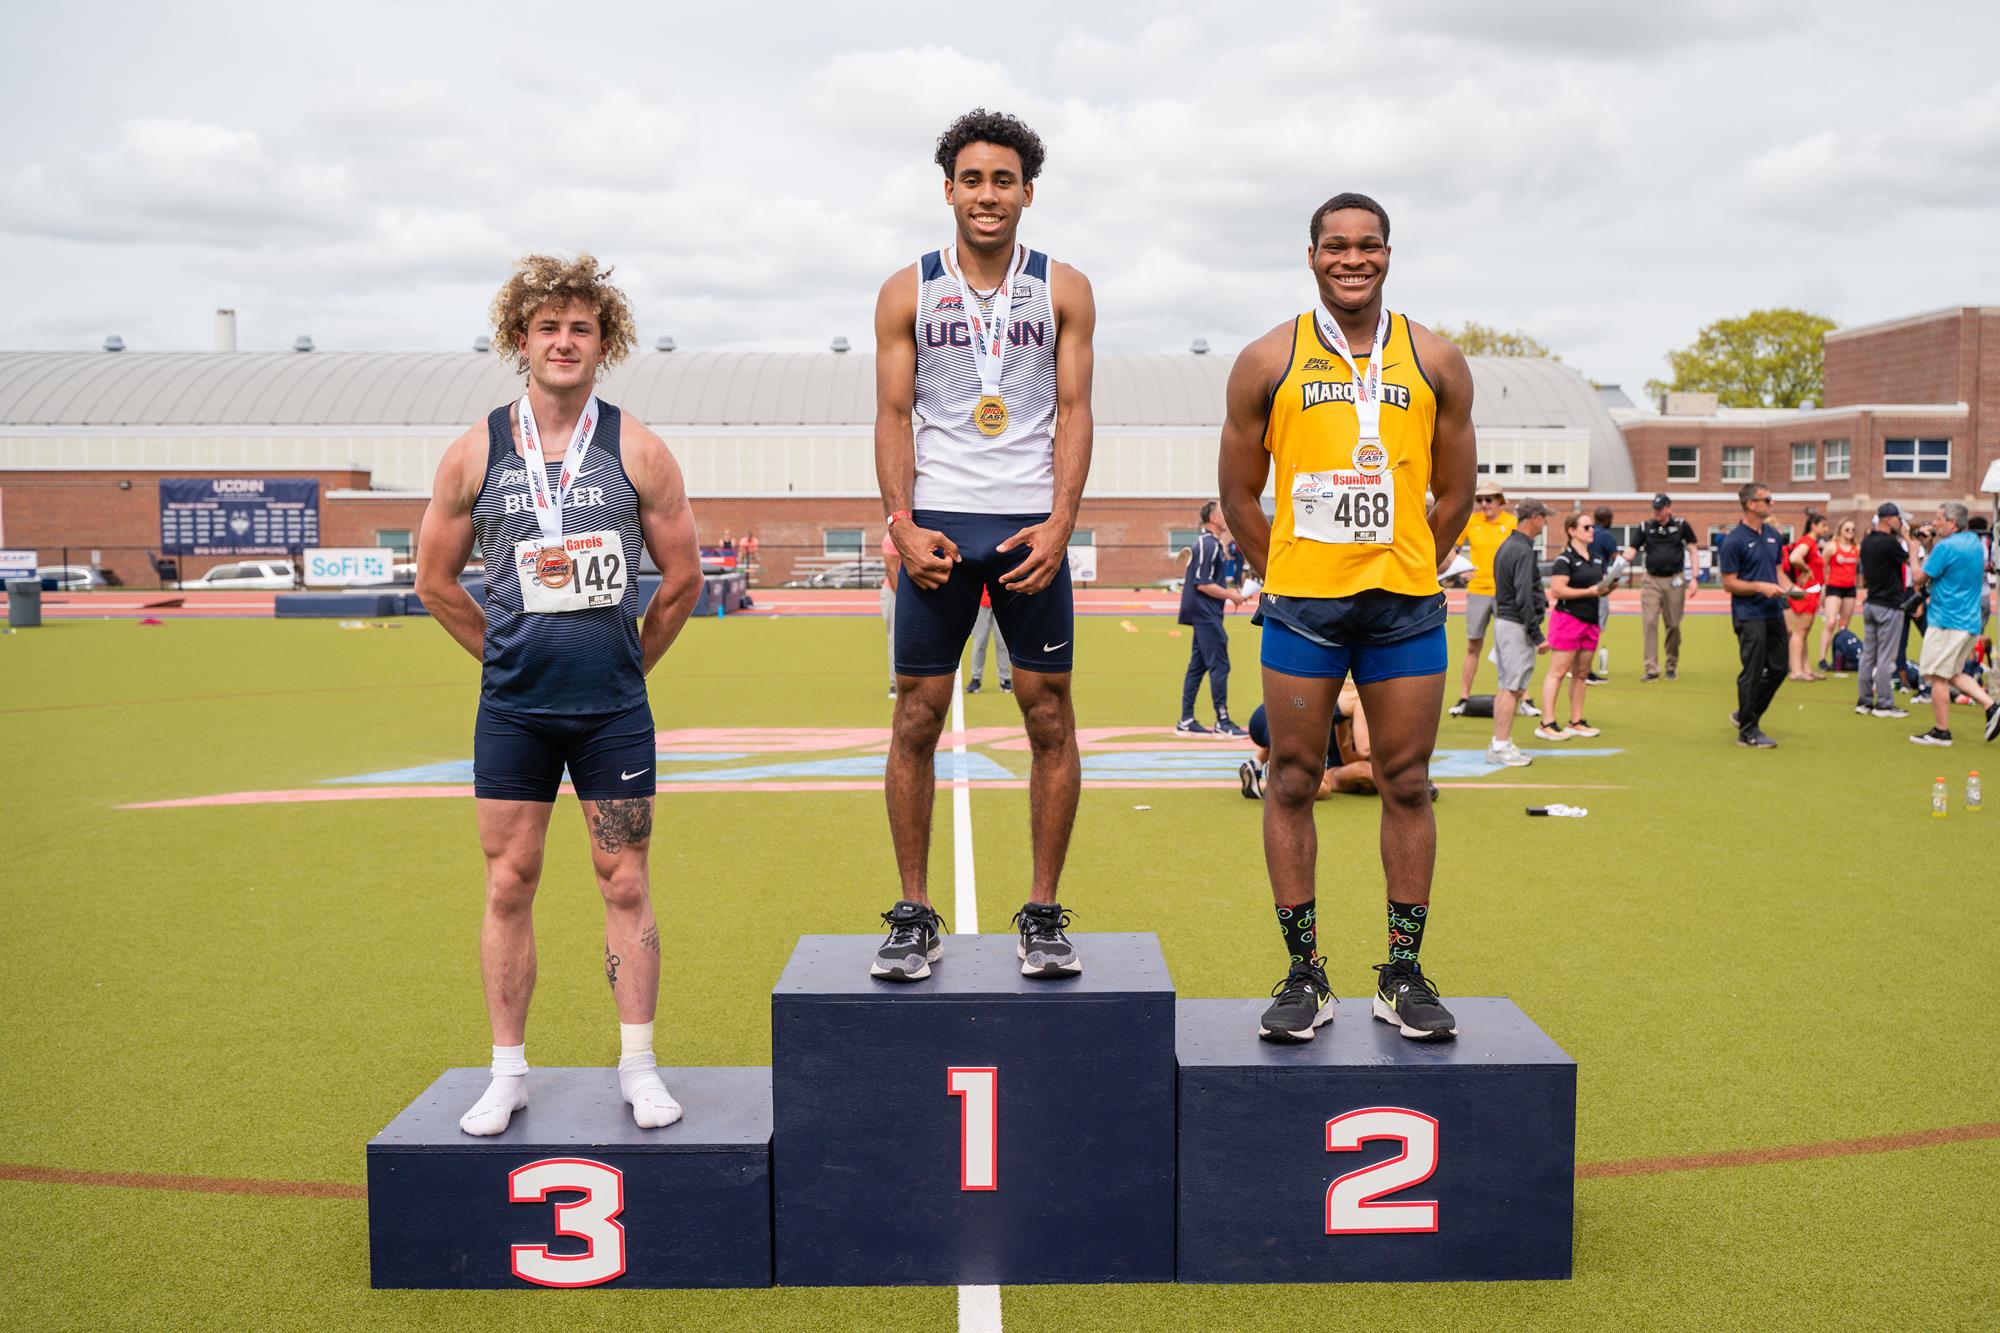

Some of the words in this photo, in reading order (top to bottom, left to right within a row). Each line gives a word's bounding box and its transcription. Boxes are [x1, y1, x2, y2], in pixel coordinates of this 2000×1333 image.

[940, 296, 963, 304] BIG
[925, 320, 1045, 347] UCNN
[973, 316, 983, 333] BIG
[978, 332, 988, 356] EAST
[994, 316, 1002, 340] EAST
[1323, 323, 1339, 339] EAST
[991, 339, 999, 356] BIG
[1302, 382, 1410, 412] MARQTTE
[583, 418, 592, 432] BIG
[577, 432, 587, 453] EAST
[213, 479, 265, 493] UCONN
[532, 469, 541, 492] EAST
[503, 487, 607, 514] BUER
[536, 491, 546, 508] BIG
[1334, 492, 1389, 528] 468
[565, 536, 604, 552] Gareis
[312, 557, 359, 577] SoFi
[573, 553, 622, 594] 142
[947, 1066, 997, 1191] 1
[1325, 1106, 1438, 1235] 2
[509, 1157, 627, 1288] 3
